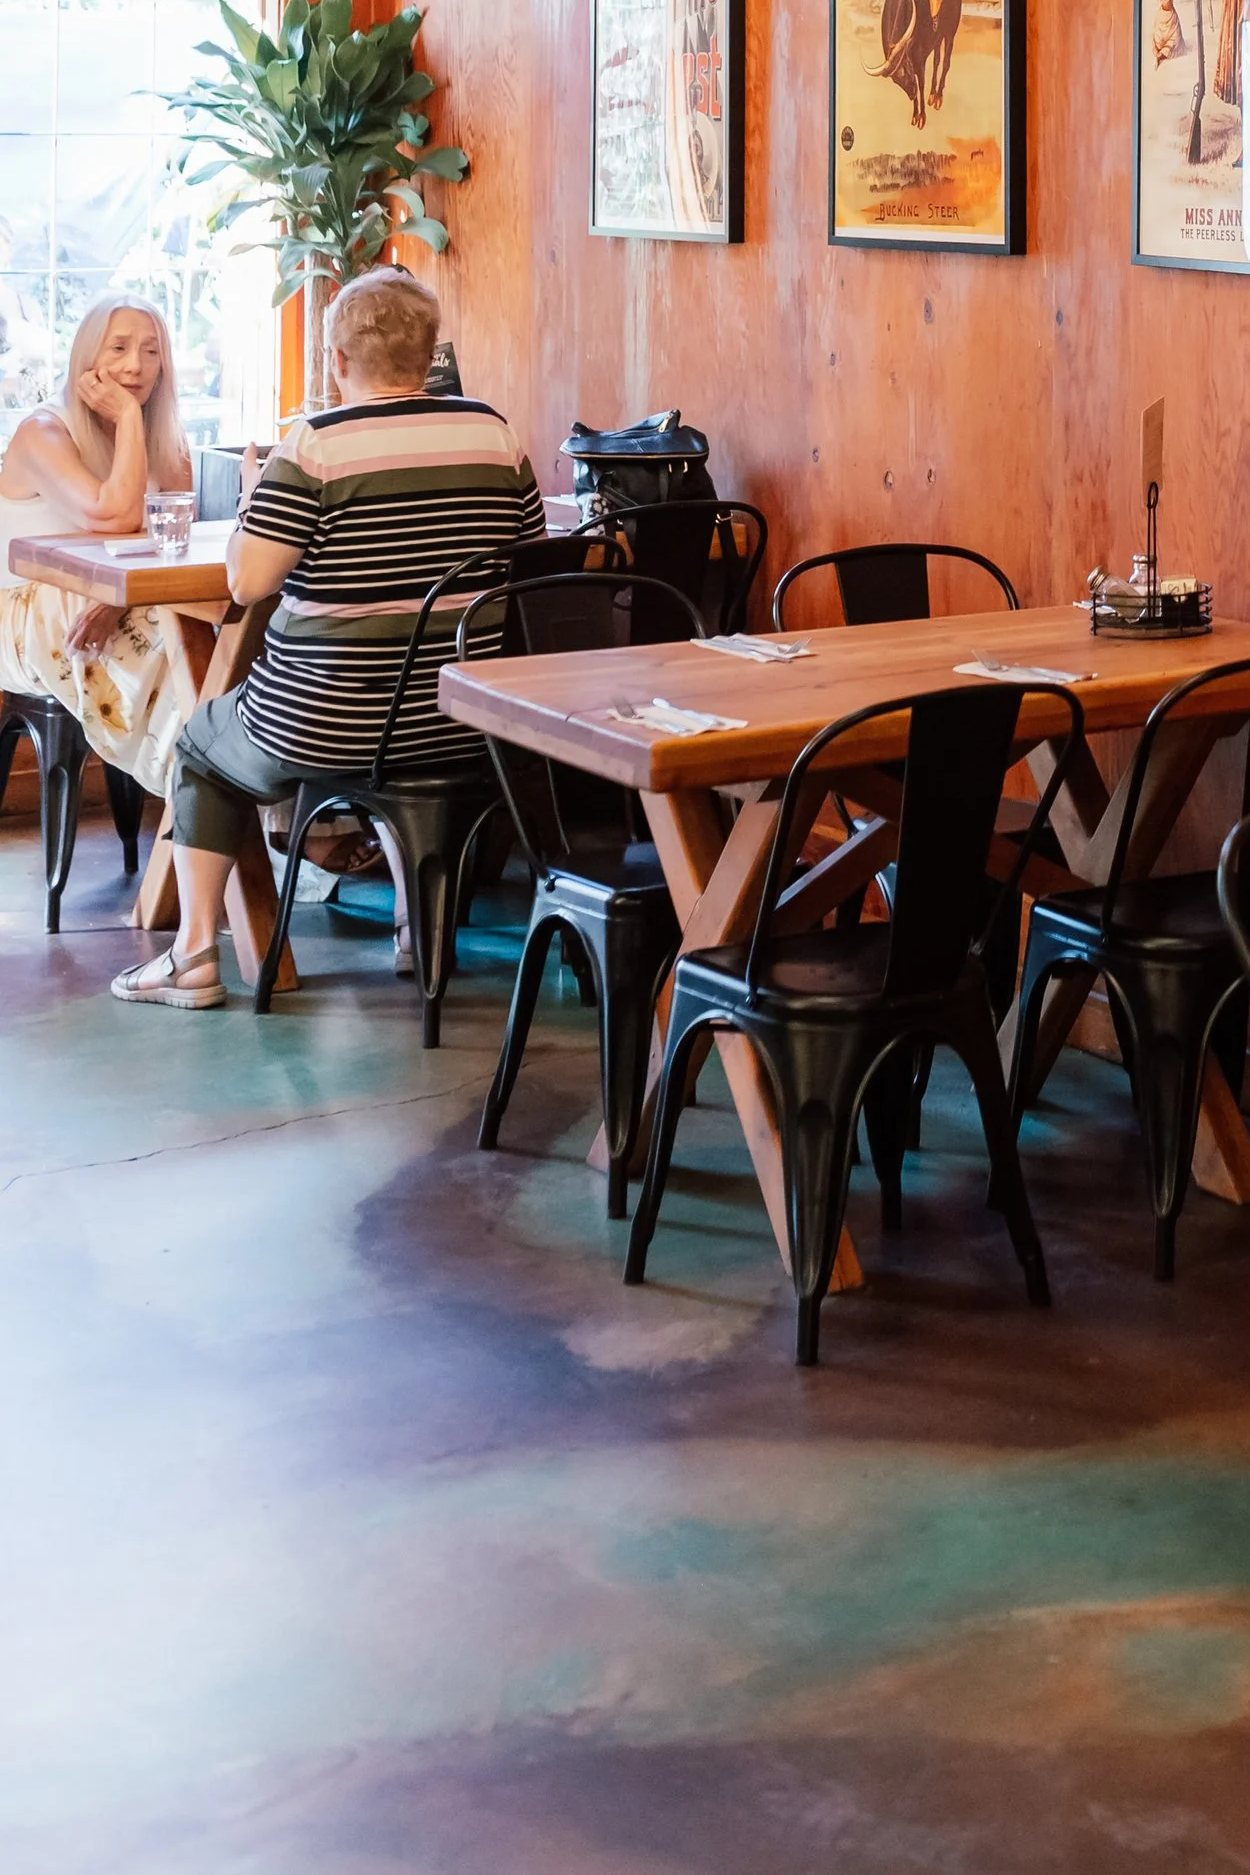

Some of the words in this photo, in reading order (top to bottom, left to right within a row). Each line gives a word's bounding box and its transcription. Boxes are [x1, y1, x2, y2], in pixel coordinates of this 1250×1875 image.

[875, 202, 920, 221] BUCKING
[928, 203, 960, 221] STEER
[1185, 207, 1213, 226] MISS
[1218, 209, 1243, 227] ANN
[1180, 228, 1194, 239] THE
[1196, 229, 1236, 242] PEERLESS
